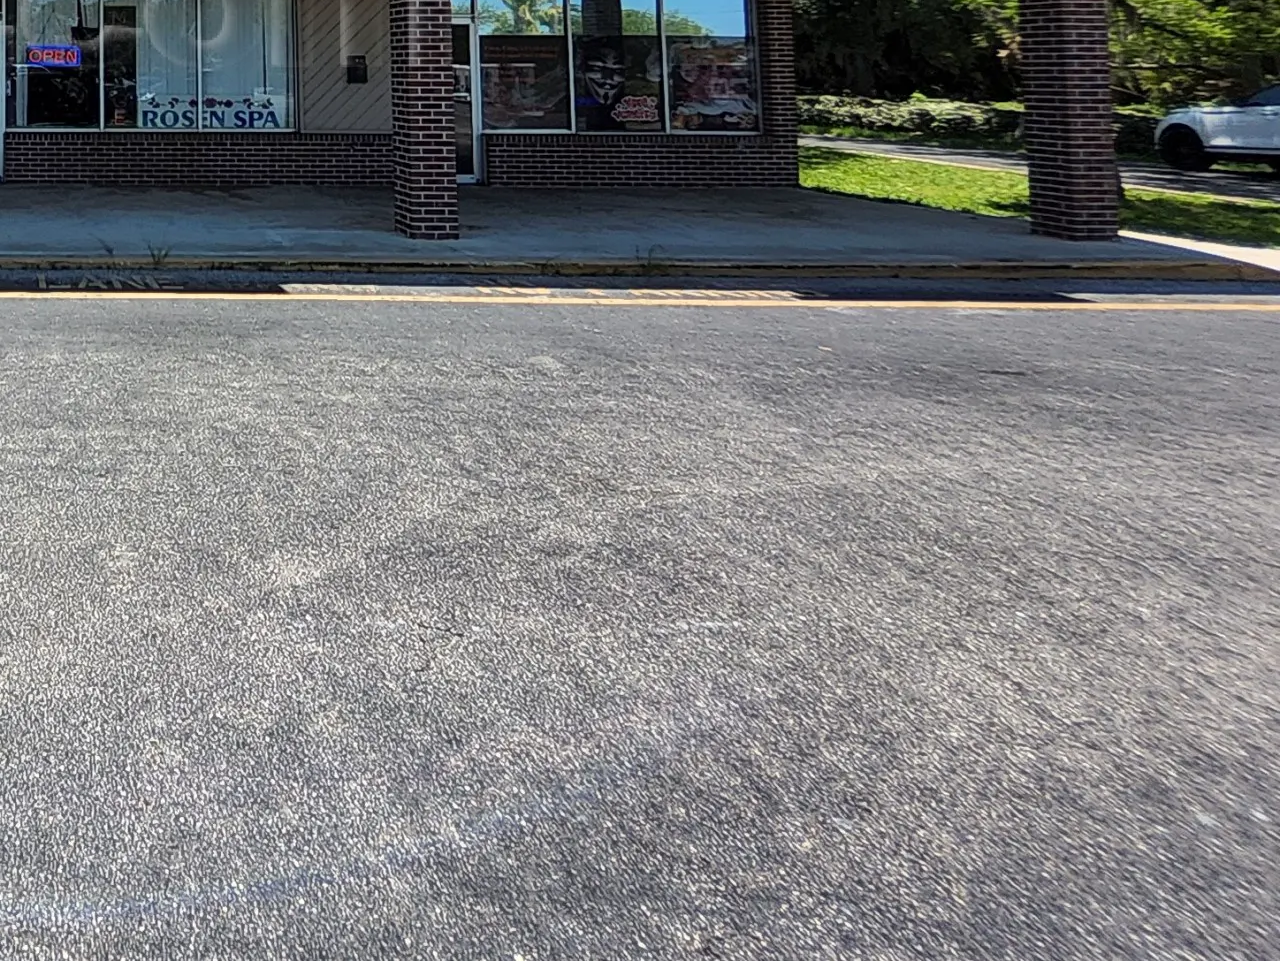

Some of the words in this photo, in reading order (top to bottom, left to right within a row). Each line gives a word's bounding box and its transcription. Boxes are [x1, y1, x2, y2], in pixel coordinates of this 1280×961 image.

[28, 48, 78, 64] OPEN
[141, 109, 230, 128] ROSEN
[233, 109, 281, 129] SPA
[35, 272, 184, 289] LANE
